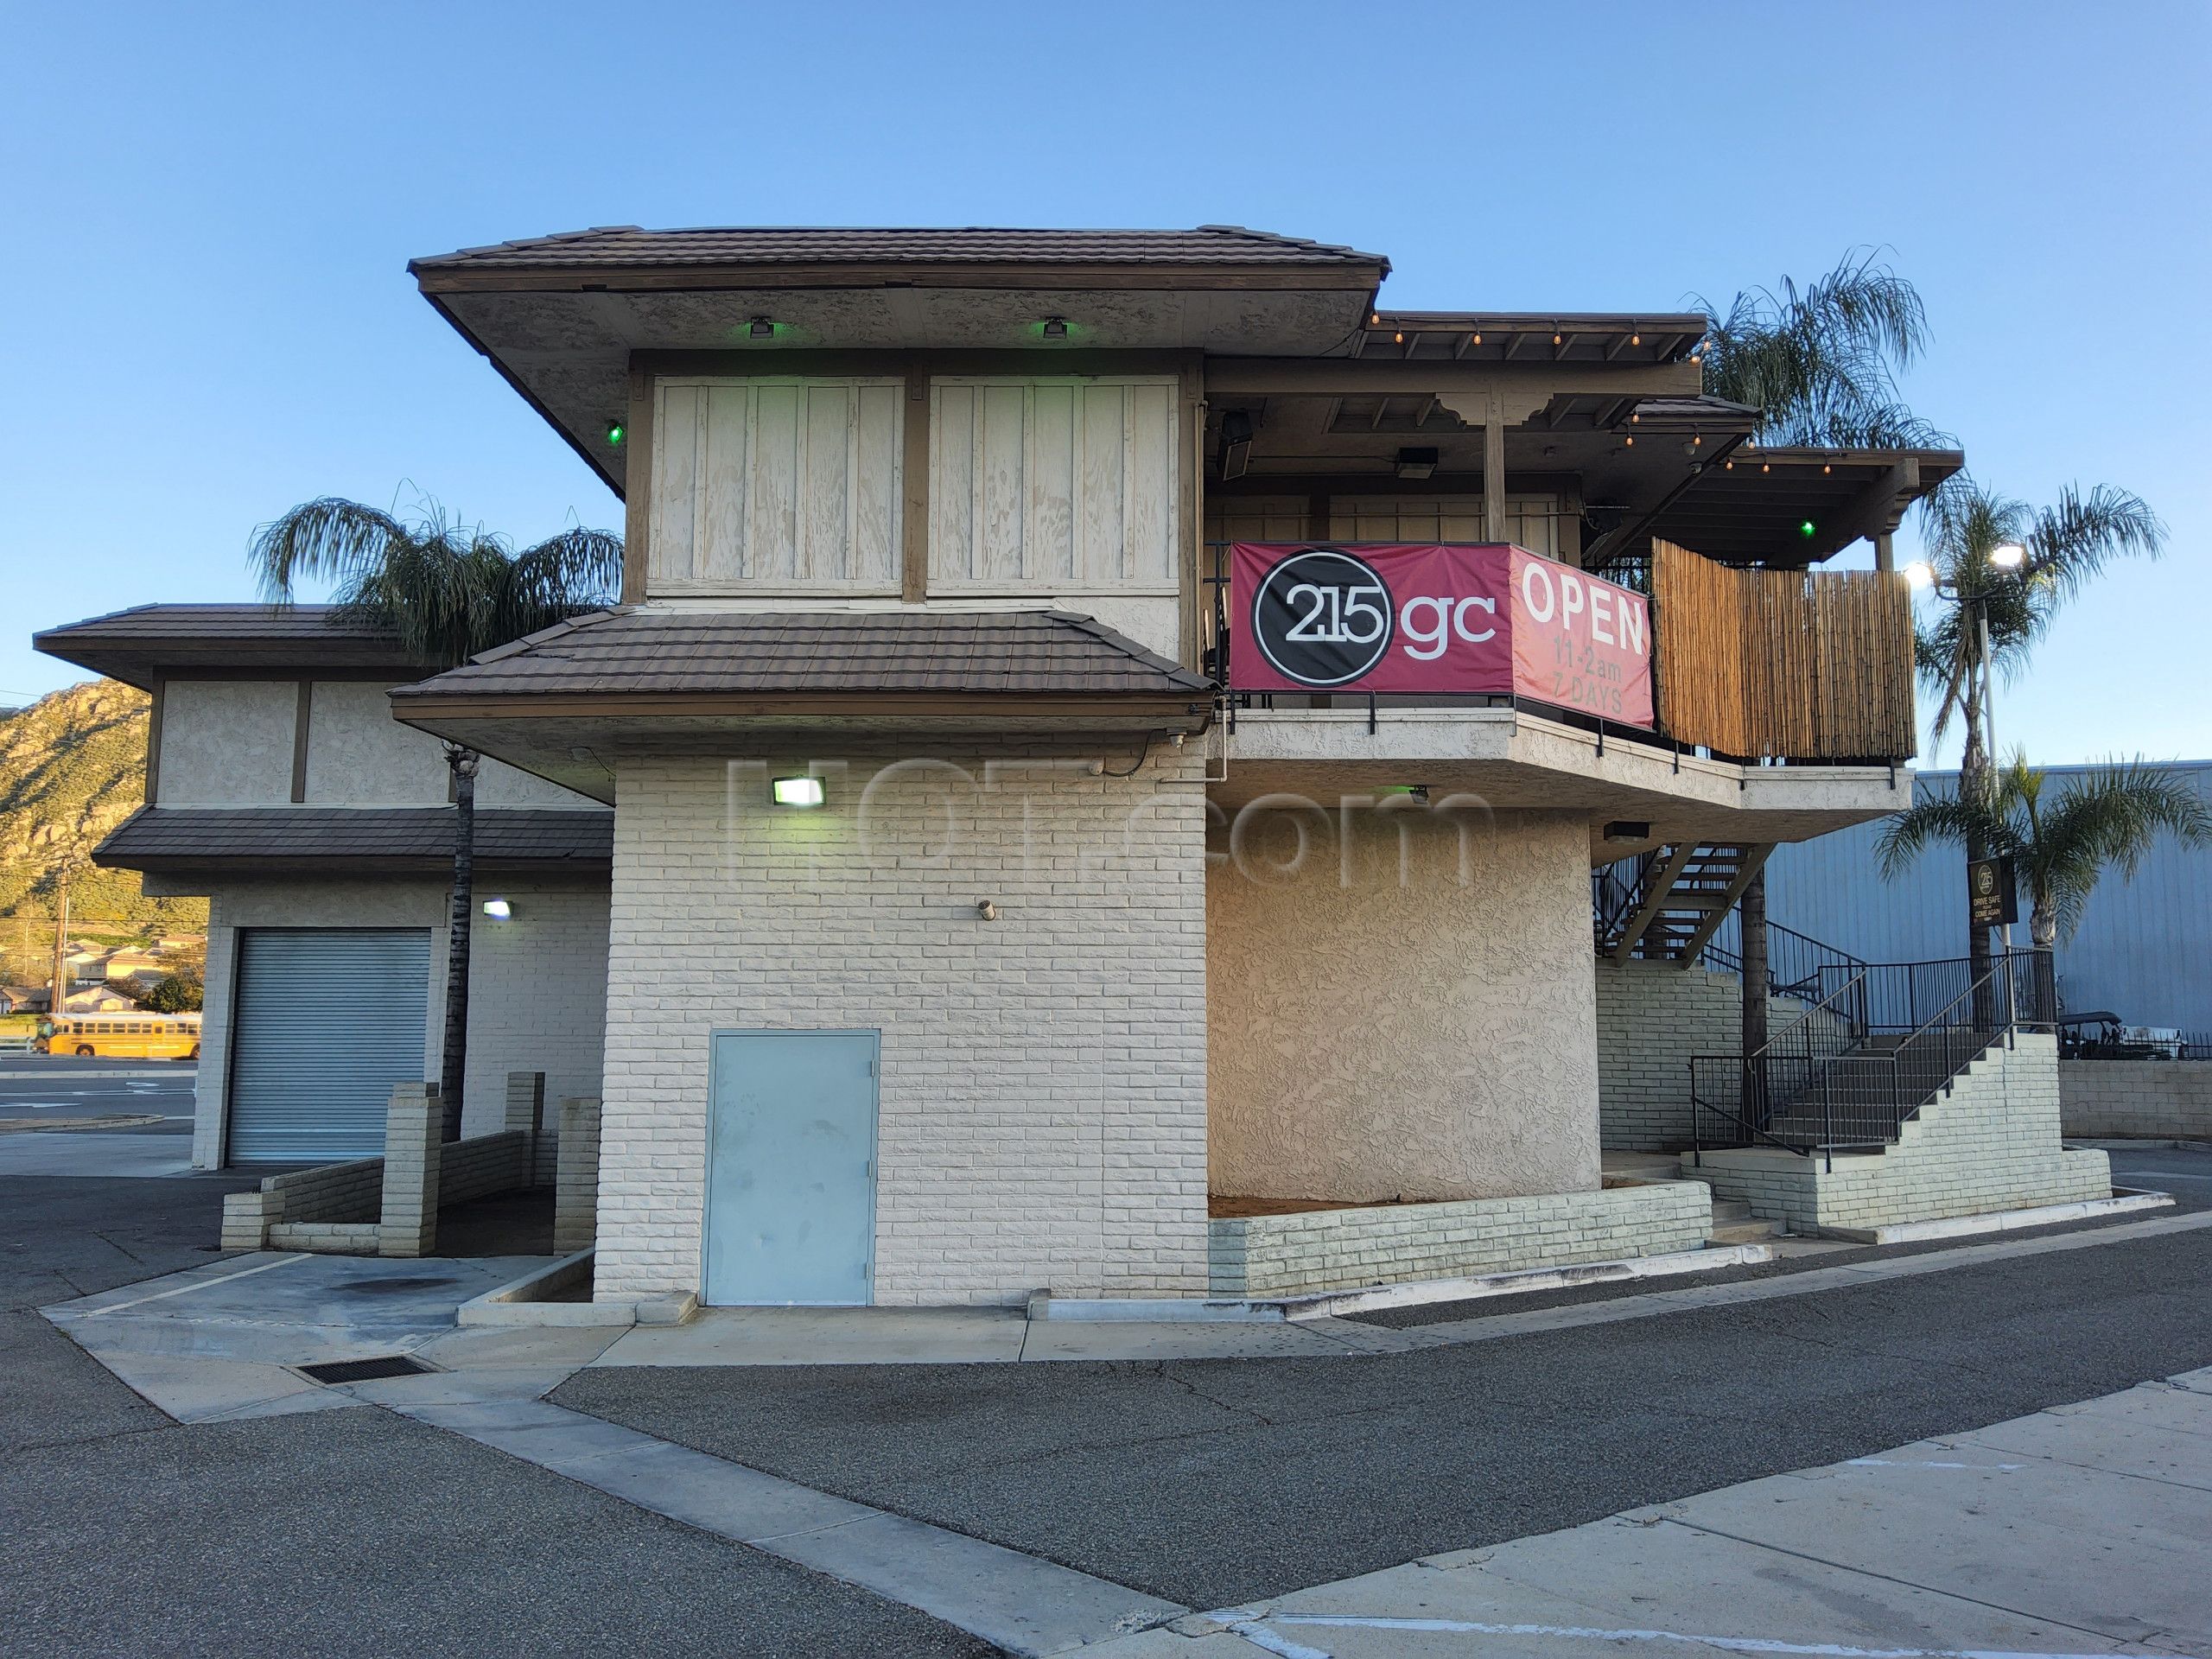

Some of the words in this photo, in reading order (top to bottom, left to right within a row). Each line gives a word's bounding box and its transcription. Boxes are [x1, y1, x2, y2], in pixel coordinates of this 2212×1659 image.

[1285, 583, 1384, 643] 215
[1400, 595, 1497, 660] gc
[1522, 563, 1642, 655] OPEN
[1554, 635, 1622, 683] 11-2am
[1553, 671, 1564, 699] 7
[1572, 676, 1623, 715] DAYS
[1974, 898, 1987, 906] DRIVE
[1988, 894, 2001, 904] SAFE
